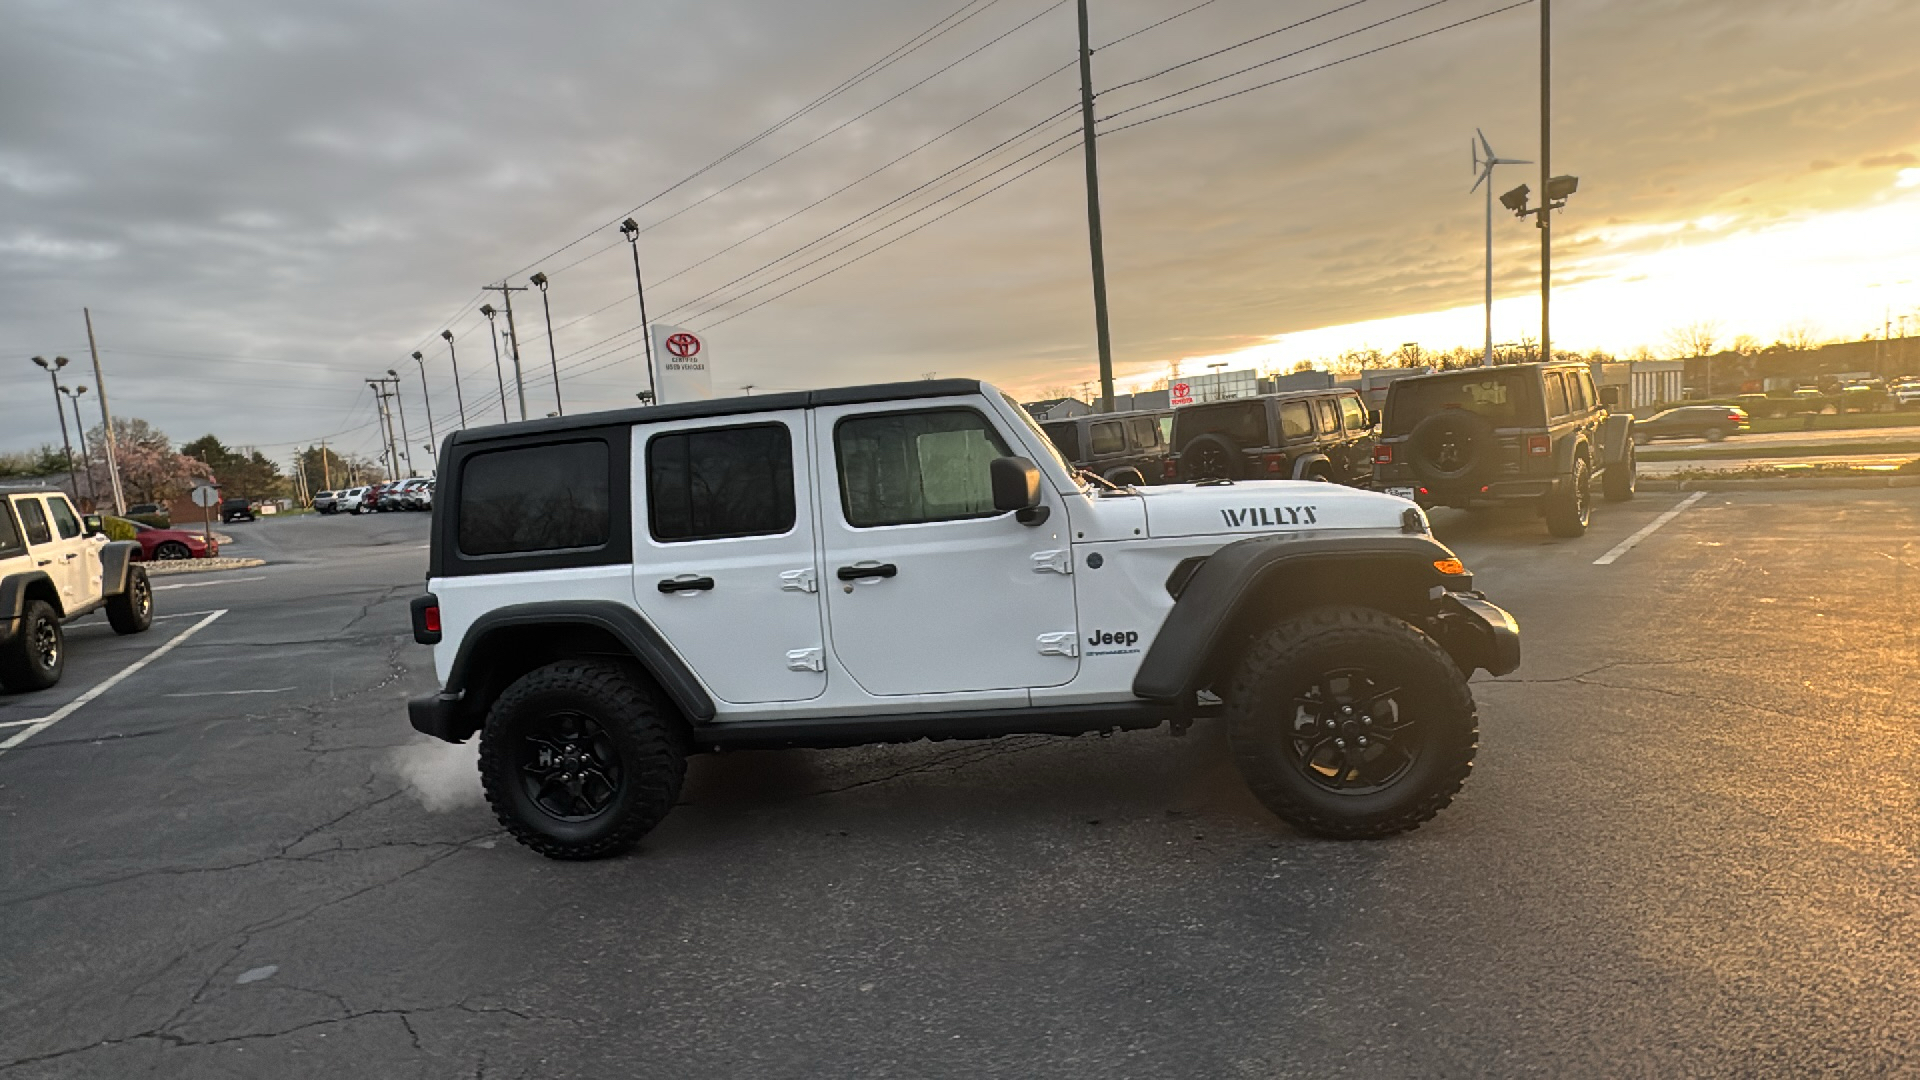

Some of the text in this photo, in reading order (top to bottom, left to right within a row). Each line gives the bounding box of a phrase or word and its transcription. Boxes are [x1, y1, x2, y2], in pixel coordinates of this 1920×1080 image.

[1171, 397, 1193, 405] TOYOTA
[1220, 506, 1316, 527] WILLYS
[1088, 629, 1139, 646] Jeep
